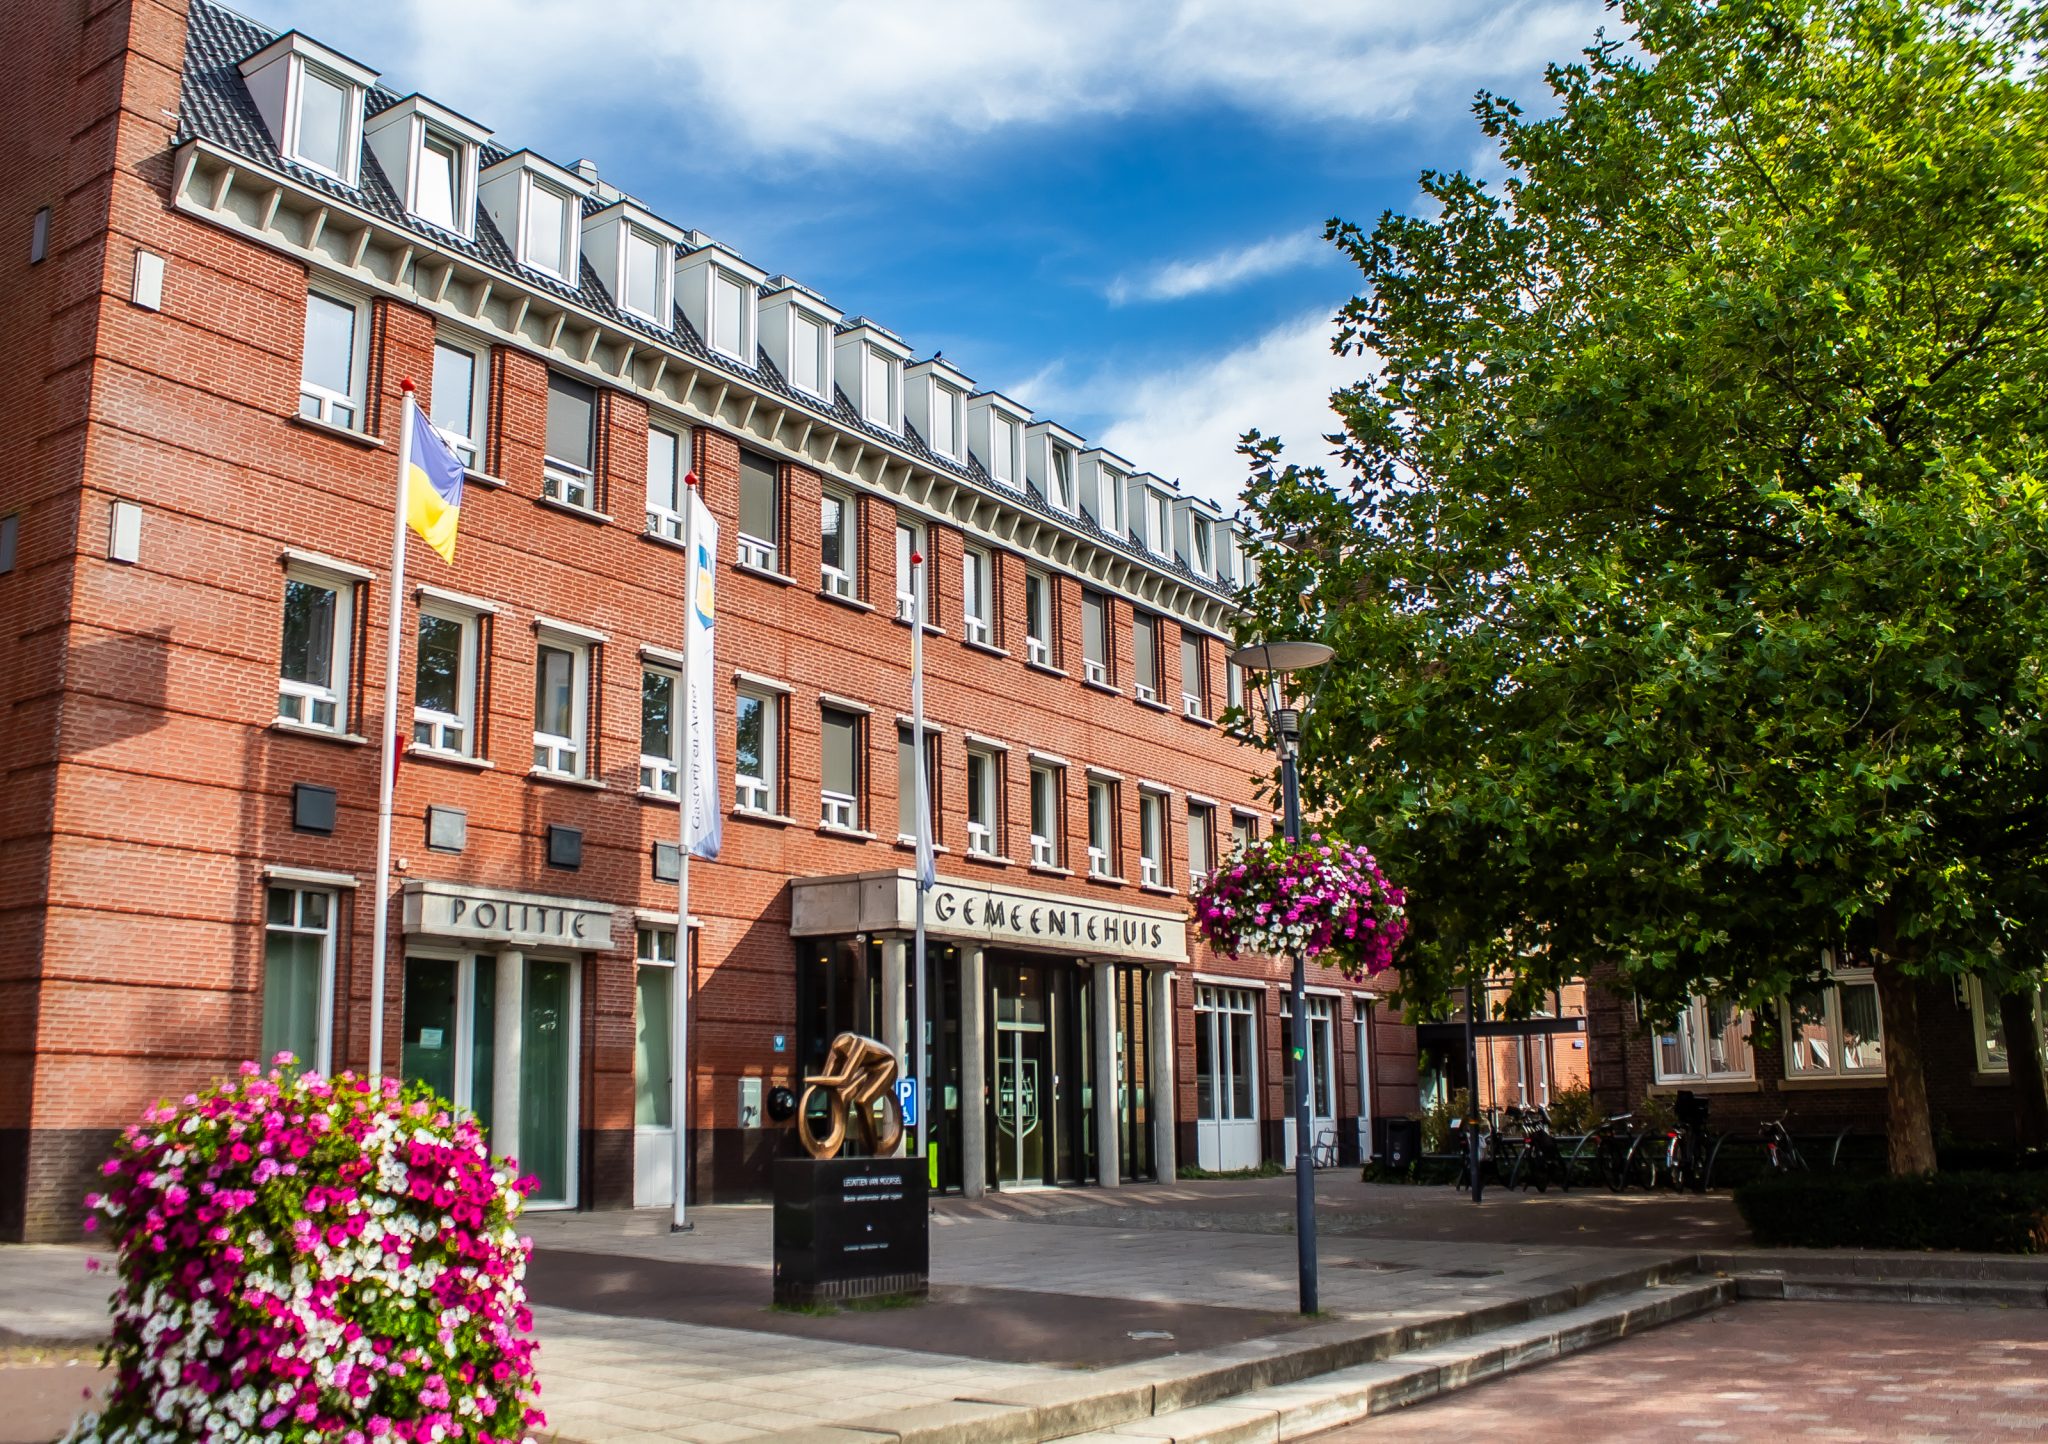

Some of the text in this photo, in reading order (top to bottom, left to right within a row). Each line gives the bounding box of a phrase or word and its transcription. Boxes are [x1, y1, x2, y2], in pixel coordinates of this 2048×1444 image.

[692, 739, 699, 758] en
[691, 763, 701, 830] Gastvrij
[453, 898, 586, 938] POLITIE
[935, 892, 1162, 948] GEMEENTEHUIS
[901, 1082, 912, 1106] P
